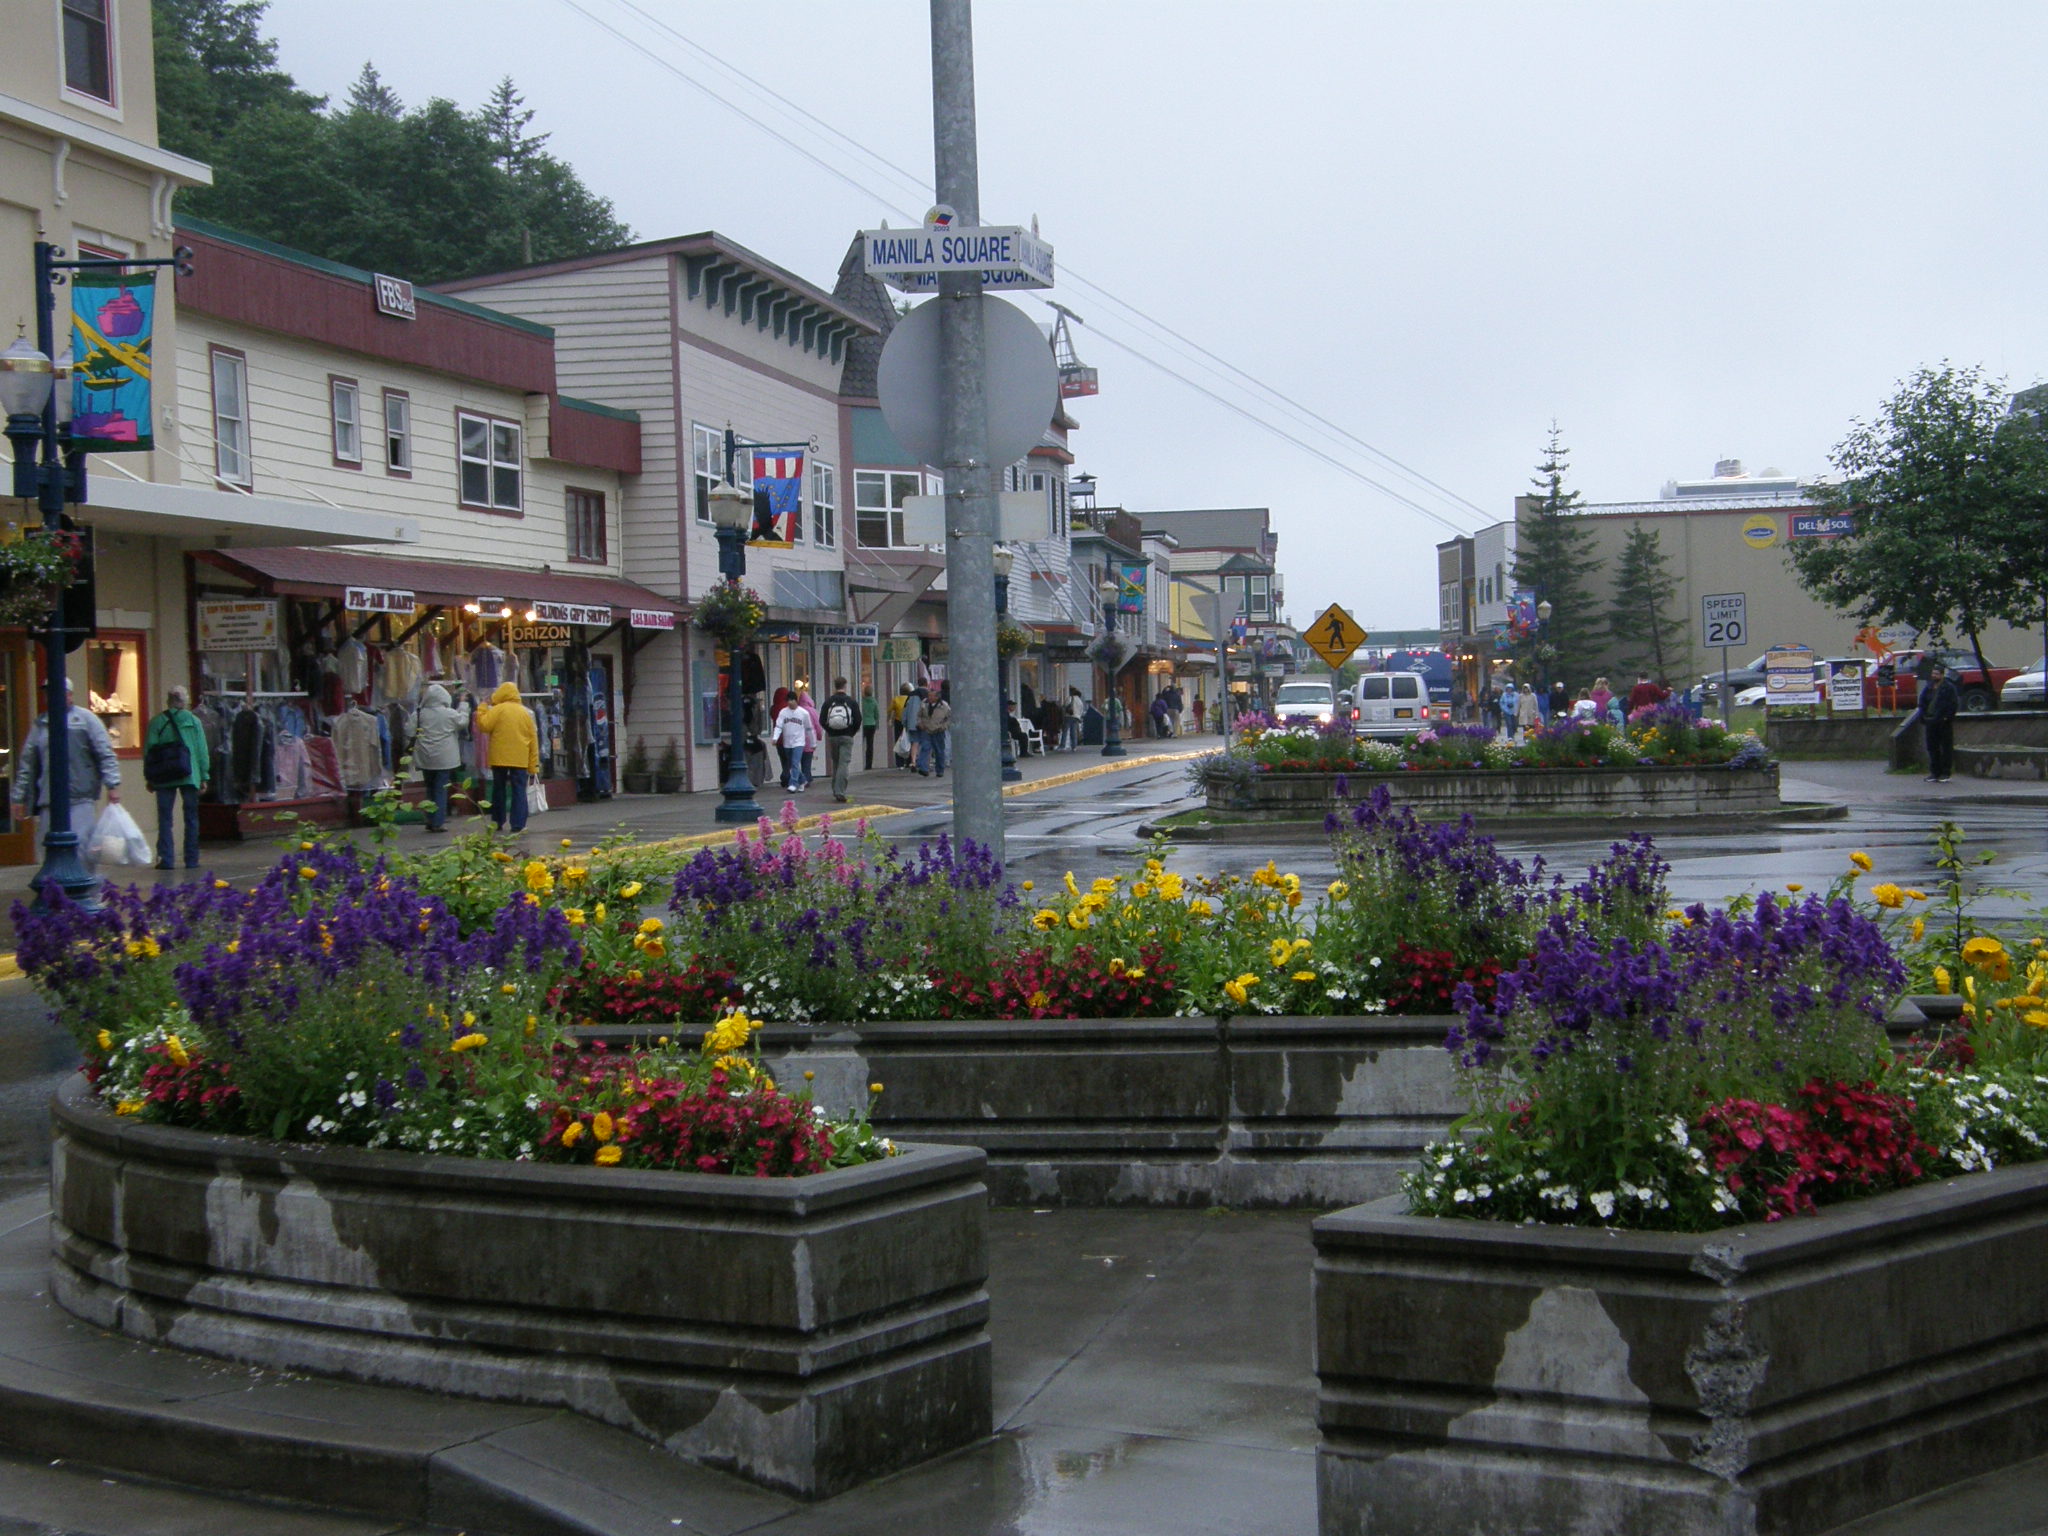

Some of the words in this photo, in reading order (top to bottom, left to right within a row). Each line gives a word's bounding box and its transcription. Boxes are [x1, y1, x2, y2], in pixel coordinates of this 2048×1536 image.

[872, 238, 935, 265] MANILA
[941, 236, 1011, 264] SQUARE
[380, 279, 403, 310] FBS
[1798, 521, 1816, 530] DEL
[1831, 520, 1849, 529] SOL
[1706, 599, 1742, 609] SPEED
[570, 607, 585, 623] GIFT
[1710, 610, 1738, 620] LIMIT
[501, 625, 571, 641] HORIZON
[1708, 621, 1742, 642] 20
